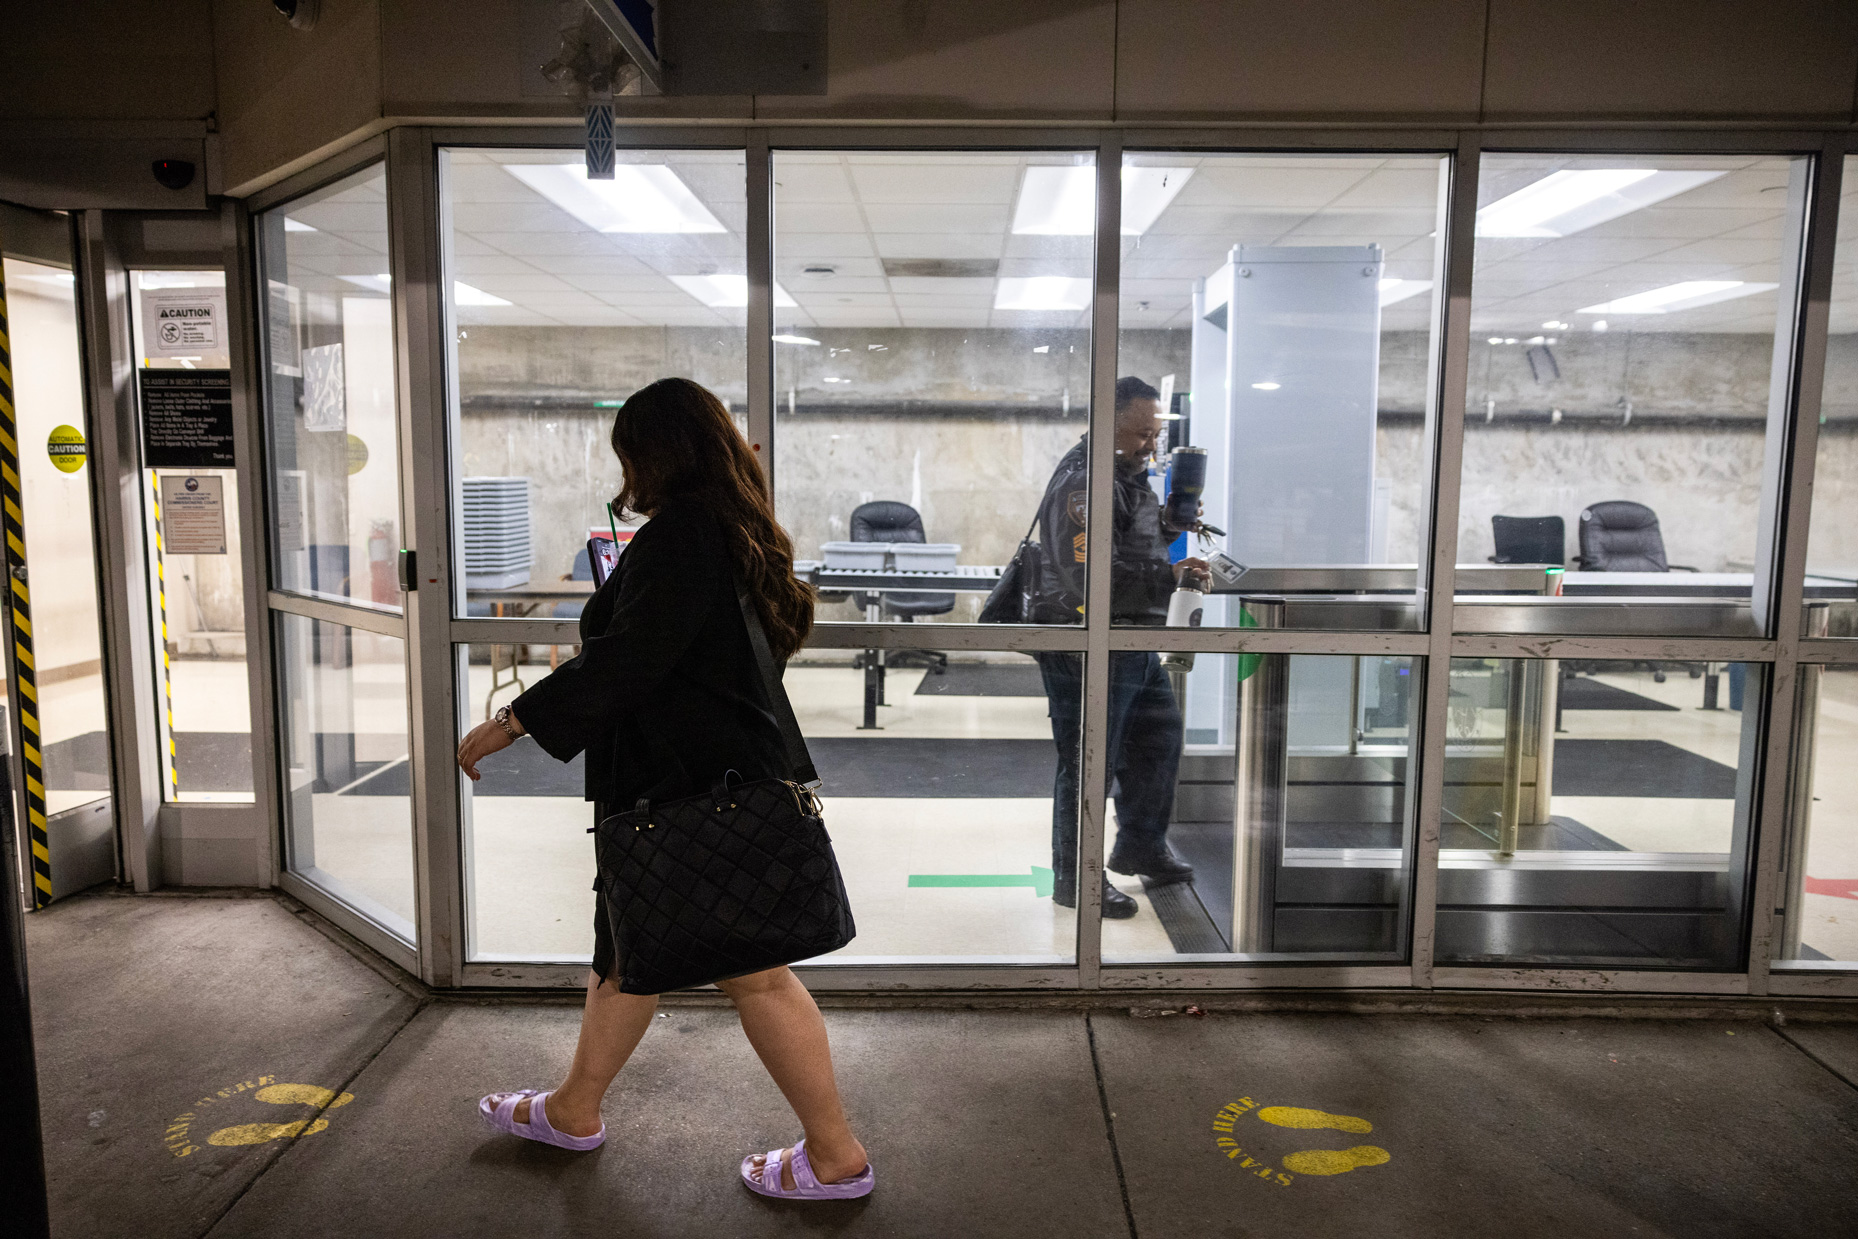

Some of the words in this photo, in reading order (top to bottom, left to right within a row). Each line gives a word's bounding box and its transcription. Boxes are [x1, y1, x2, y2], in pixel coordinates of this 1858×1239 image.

[169, 308, 210, 318] CAUTION
[48, 444, 86, 453] CAUTION
[1212, 1096, 1260, 1133] HERE
[1216, 1136, 1294, 1186] STAND
